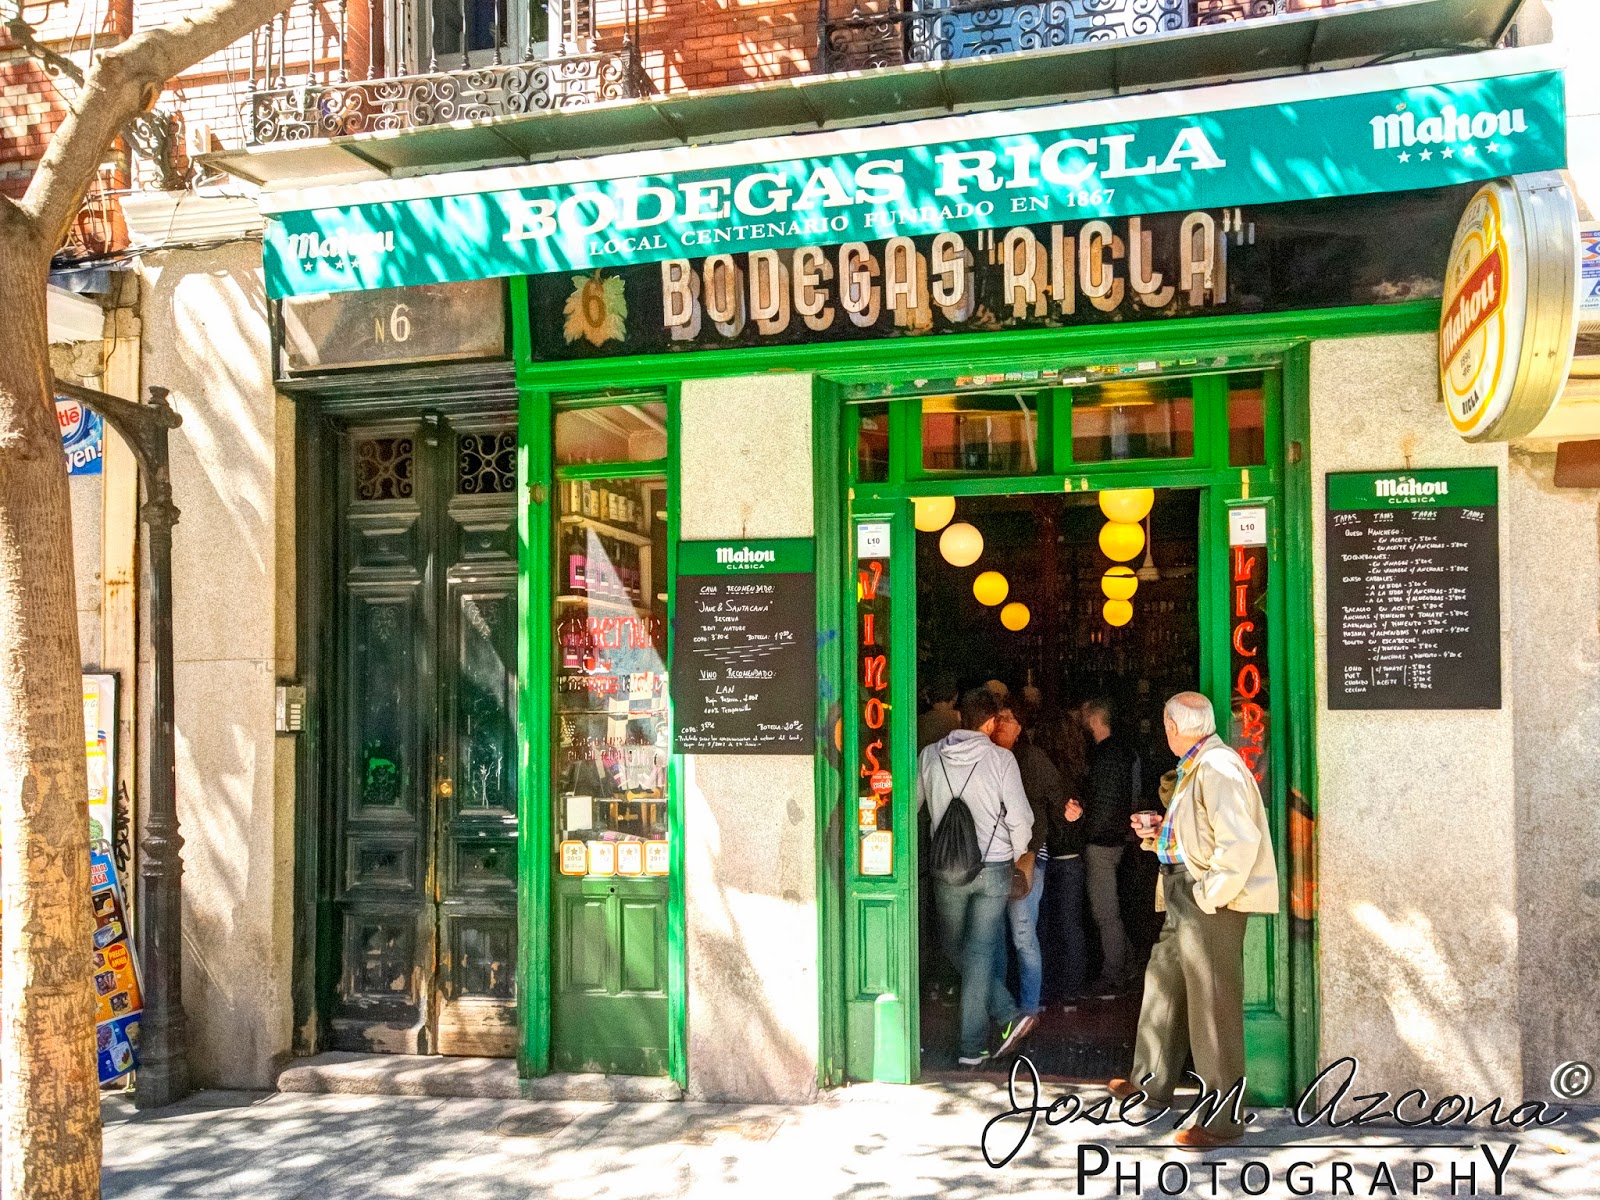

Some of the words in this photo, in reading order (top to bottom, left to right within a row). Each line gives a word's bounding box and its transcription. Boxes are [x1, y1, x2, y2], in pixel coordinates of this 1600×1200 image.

[1369, 104, 1528, 150] Mahou
[502, 158, 904, 242] BODEGAS
[934, 126, 1226, 197] RICLA
[590, 235, 667, 256] LOCAL
[680, 214, 849, 247] CENTENARIO
[864, 200, 994, 228] FUNDADO
[1010, 195, 1049, 214] EN
[1066, 188, 1115, 208] 1867
[661, 232, 966, 328] BODEGAS
[390, 303, 411, 342] 6
[1443, 271, 1497, 363] Mahou
[1462, 389, 1479, 416] RICLA
[1374, 477, 1449, 497] Mahou
[1240, 523, 1255, 531] L10
[1334, 513, 1358, 523] TAPAS
[716, 546, 775, 563] Mahou
[867, 537, 881, 545] L10
[716, 685, 735, 694] LAN
